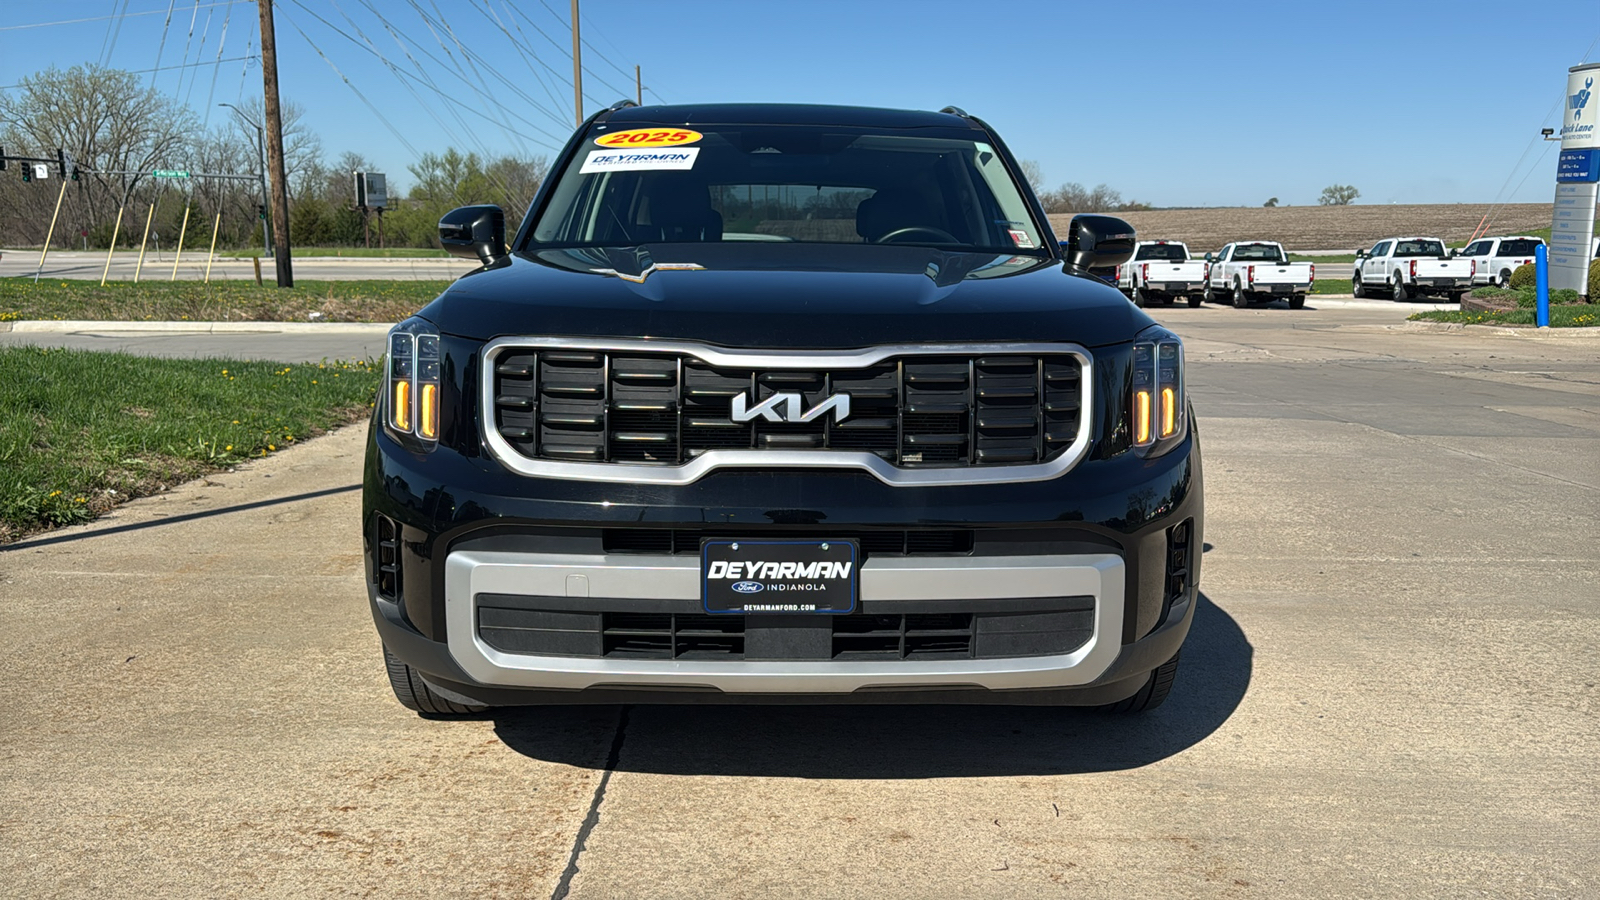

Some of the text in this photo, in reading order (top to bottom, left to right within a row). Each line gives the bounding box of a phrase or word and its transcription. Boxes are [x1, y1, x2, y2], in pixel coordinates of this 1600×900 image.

[1575, 123, 1594, 132] Lane
[606, 132, 692, 144] 2025
[592, 154, 690, 163] DEYARMAN
[732, 391, 850, 423] KIA
[707, 561, 852, 579] DEYARMAN
[737, 582, 826, 591] Ford INDIANOLA
